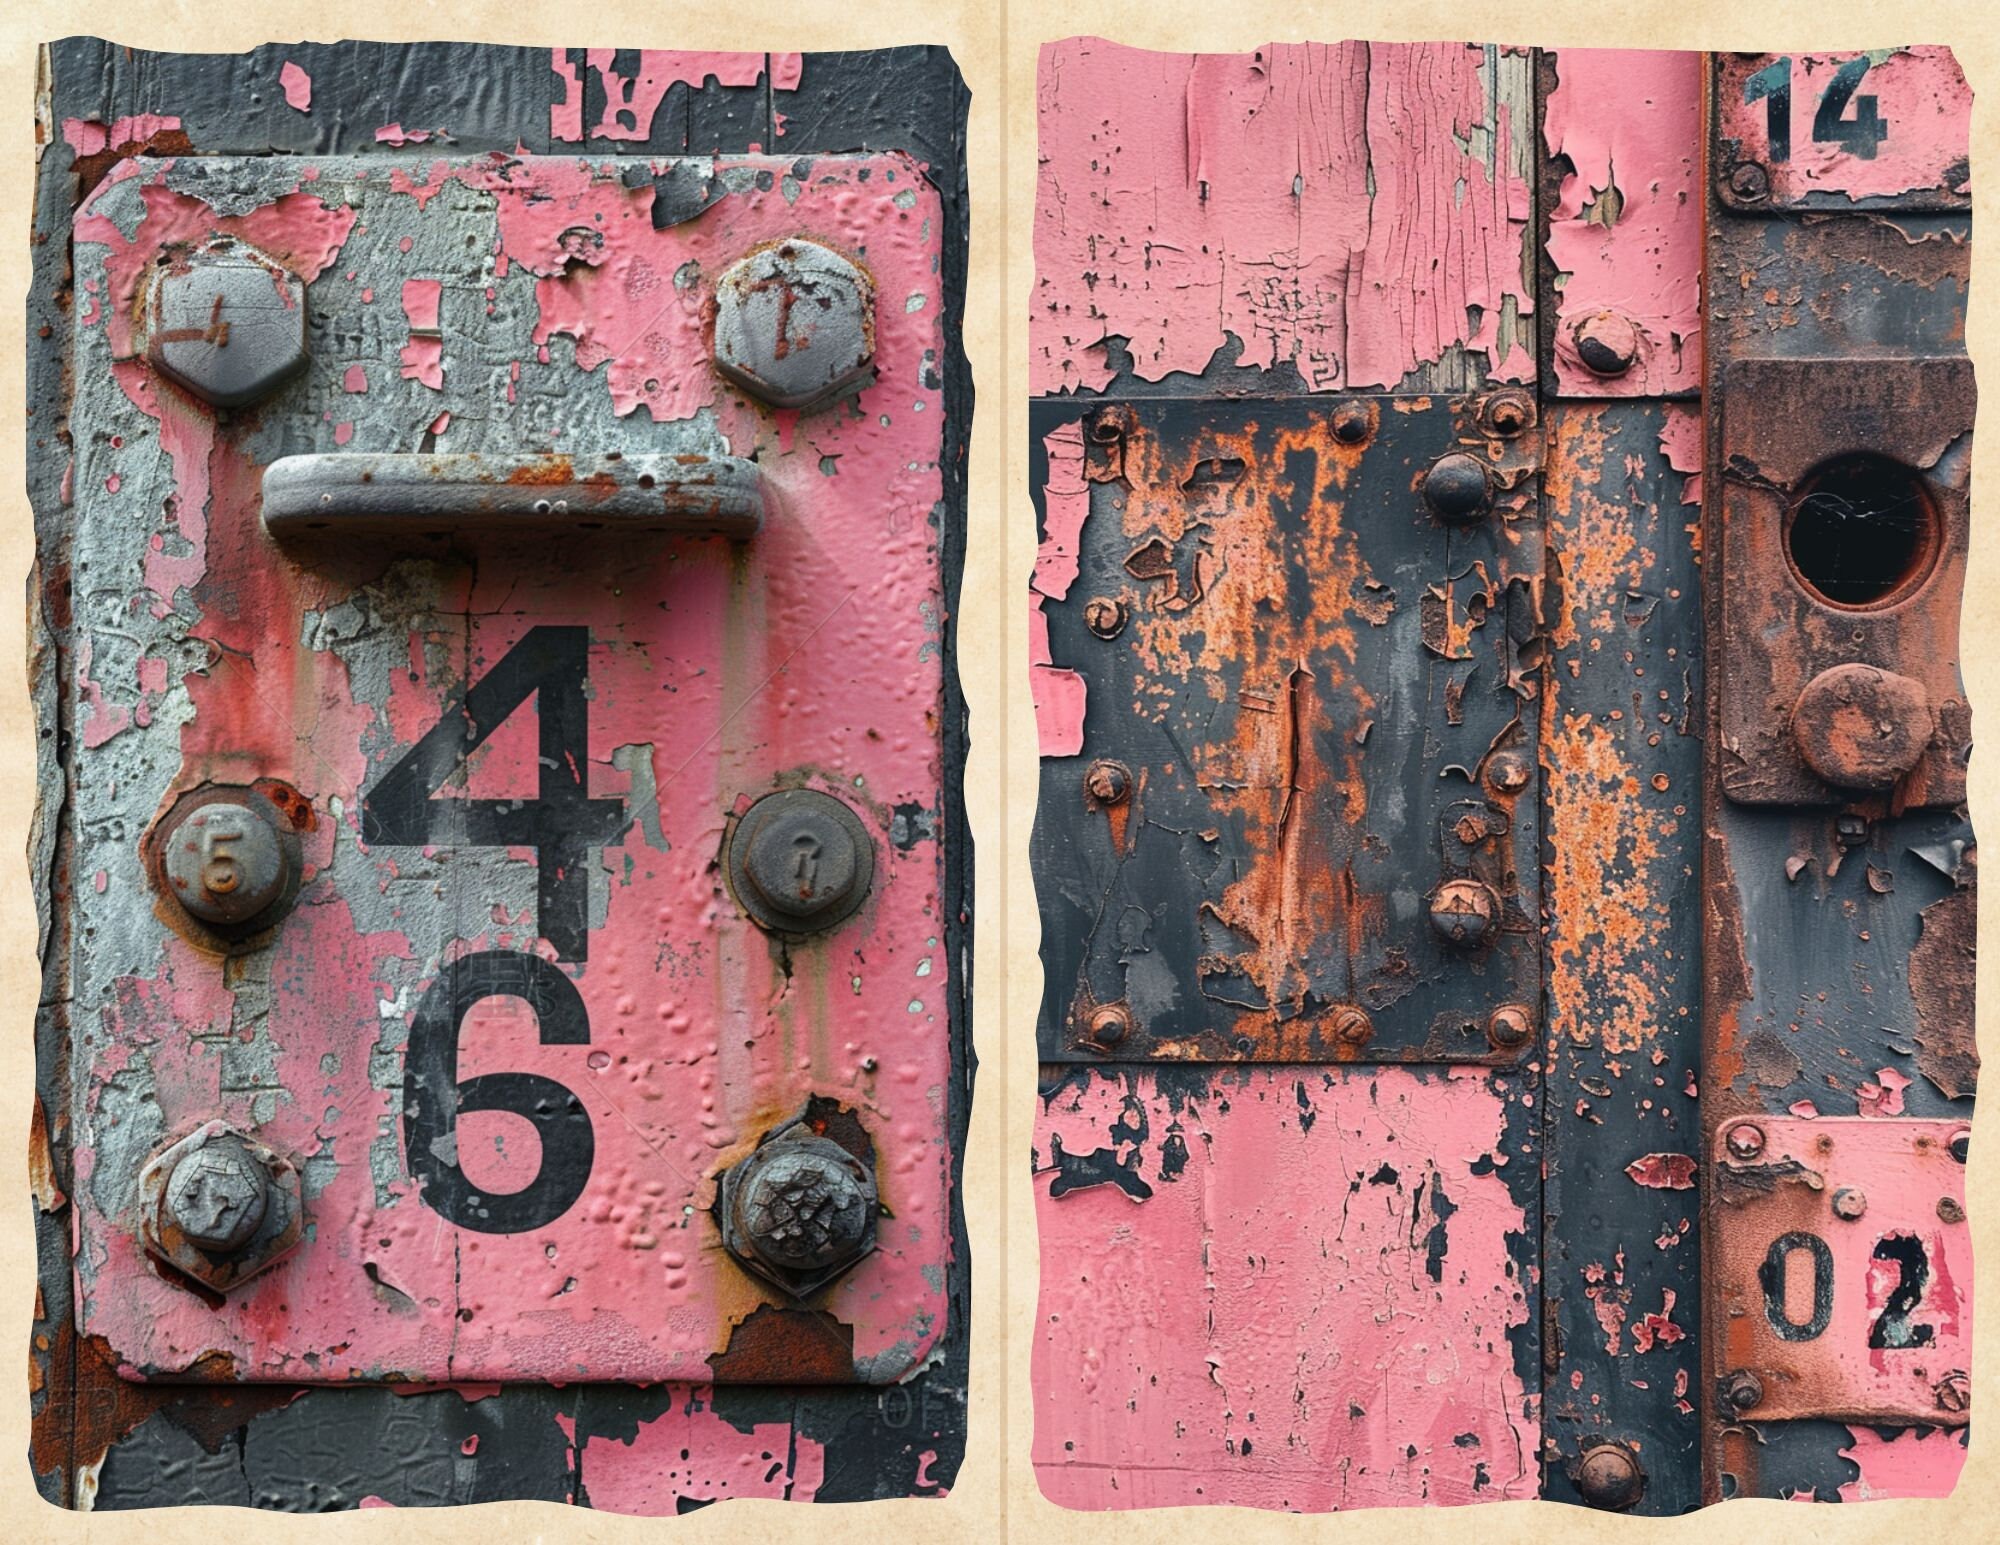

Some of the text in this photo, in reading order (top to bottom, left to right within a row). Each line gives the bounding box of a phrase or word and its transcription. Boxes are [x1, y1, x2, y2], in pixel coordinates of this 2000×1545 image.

[1743, 55, 1888, 163] 14
[361, 626, 624, 962] 4
[403, 950, 595, 1234] 6
